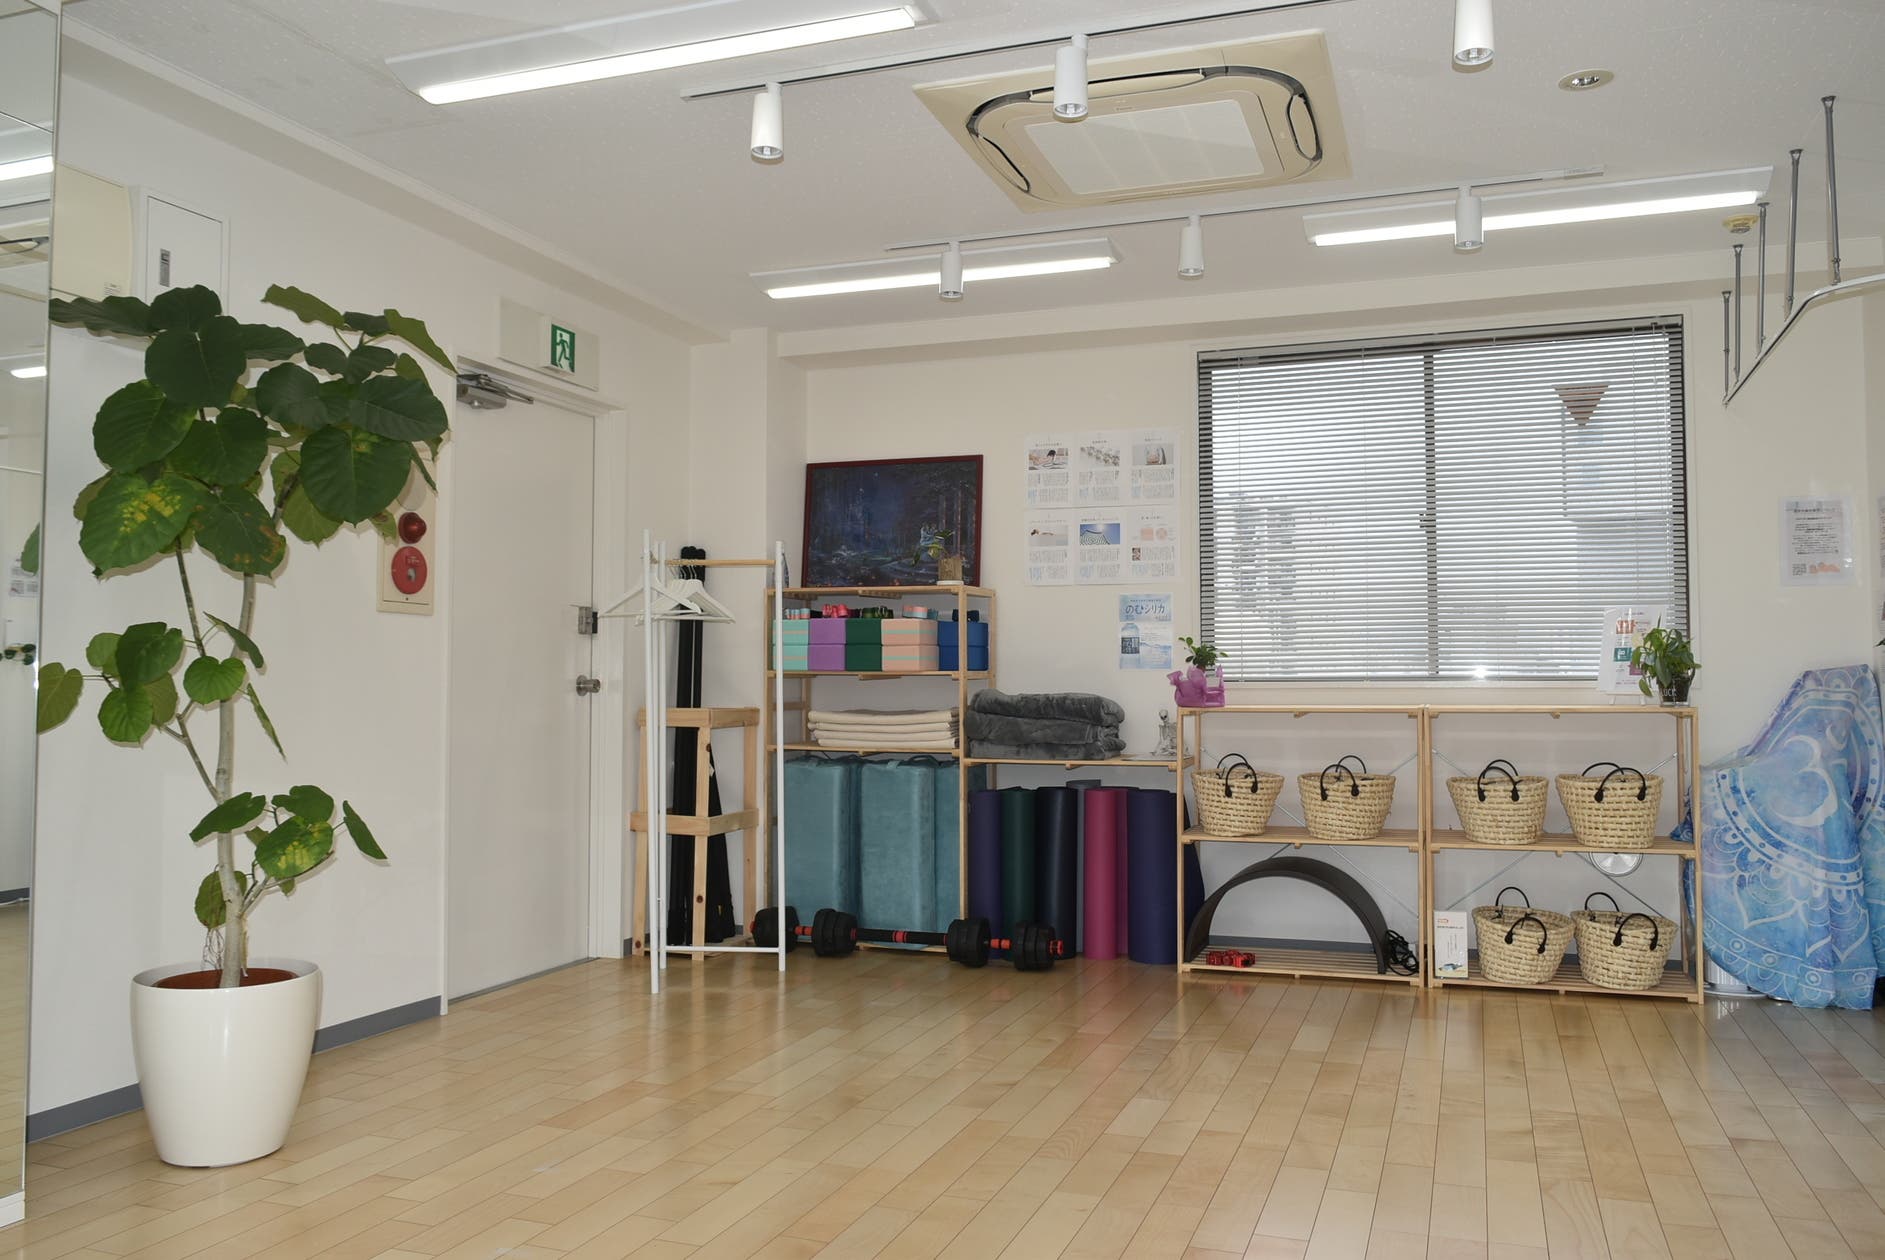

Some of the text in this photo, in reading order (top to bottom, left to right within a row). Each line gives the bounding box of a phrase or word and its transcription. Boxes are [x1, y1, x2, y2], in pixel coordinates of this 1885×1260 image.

[1125, 604, 1165, 615] のむシリカ
